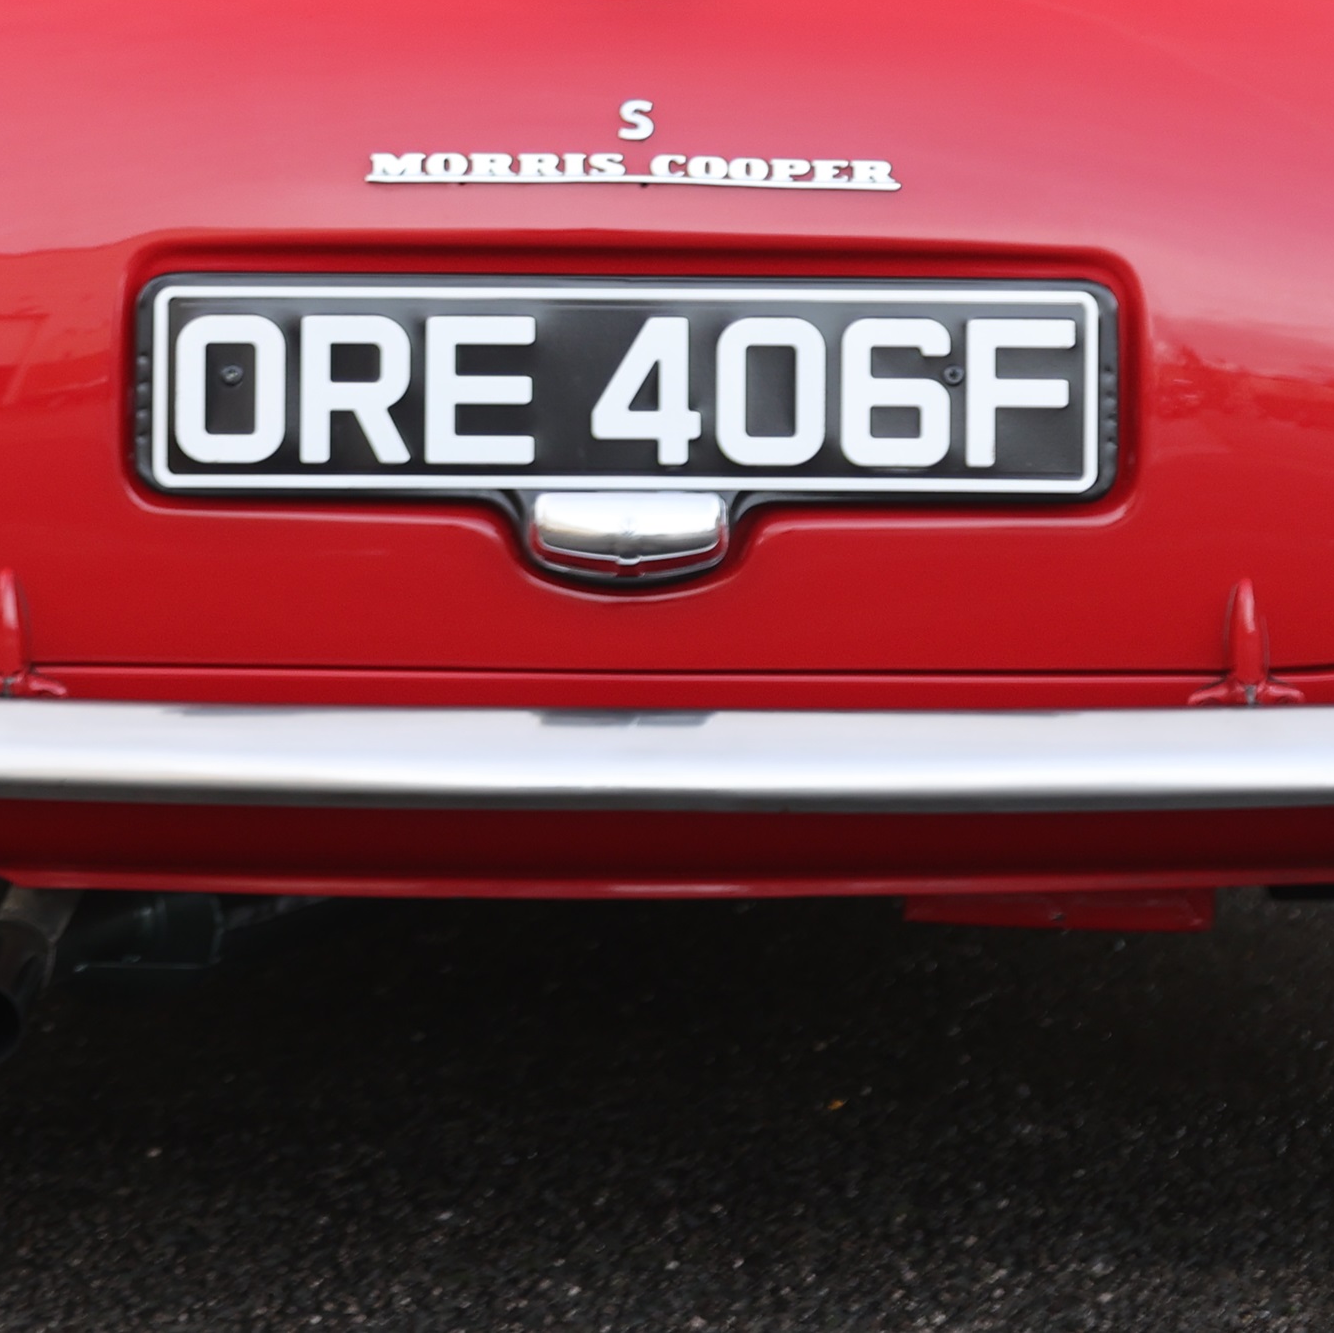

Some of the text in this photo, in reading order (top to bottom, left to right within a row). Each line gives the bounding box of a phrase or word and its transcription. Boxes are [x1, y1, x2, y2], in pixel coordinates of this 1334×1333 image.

[618, 99, 655, 141] S
[369, 152, 895, 185] MORRIS COOPER
[174, 313, 1077, 468] ORE 406F
